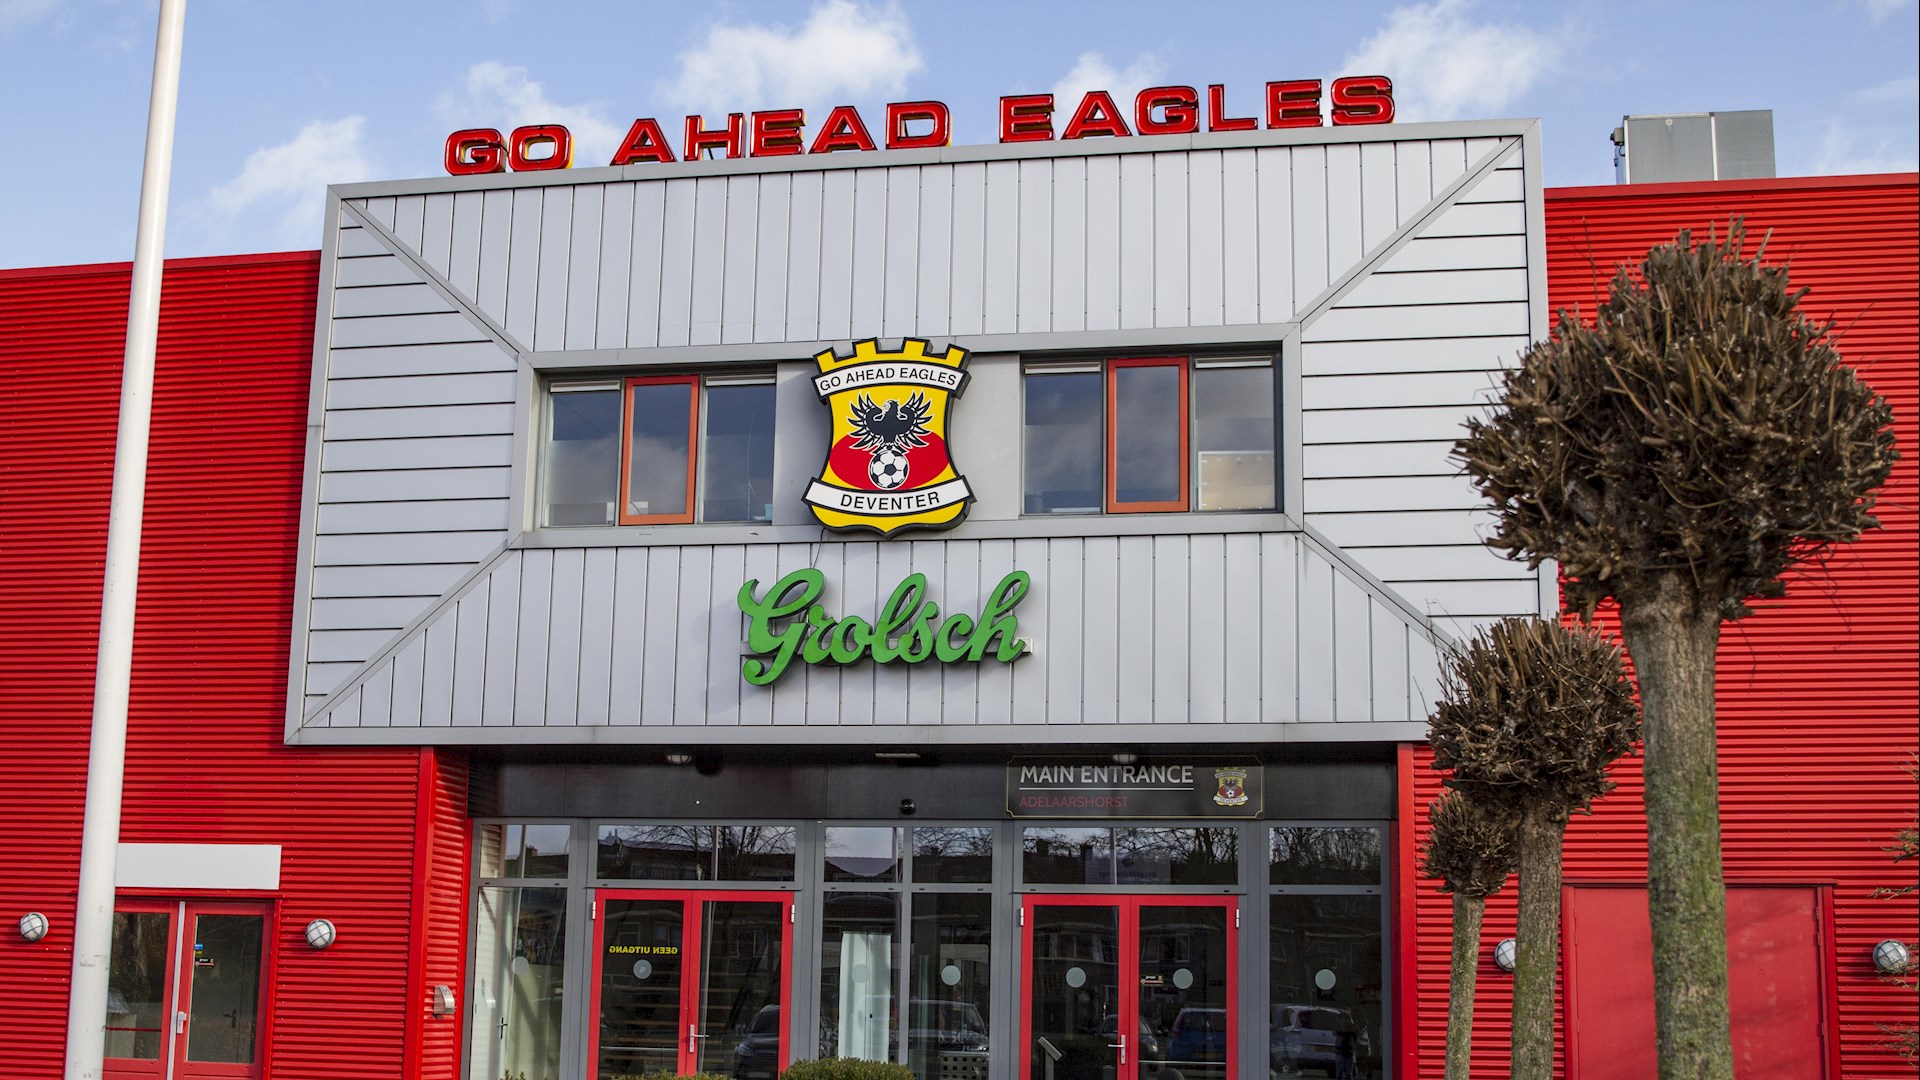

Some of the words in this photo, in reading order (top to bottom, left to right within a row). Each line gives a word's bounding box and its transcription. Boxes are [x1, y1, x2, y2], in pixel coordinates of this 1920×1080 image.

[444, 123, 575, 176] GO
[609, 100, 952, 166] AHEAD
[999, 75, 1395, 143] EAGLES
[820, 376, 841, 391] GO
[846, 368, 895, 384] AHEAD
[900, 368, 957, 386] EAGLES
[840, 491, 940, 511] DEVENTER
[737, 568, 1030, 686] Grolsch
[1020, 766, 1074, 783] MAIN
[1081, 765, 1194, 784] ENTRANCE
[1019, 796, 1129, 808] ADELAARSHORST
